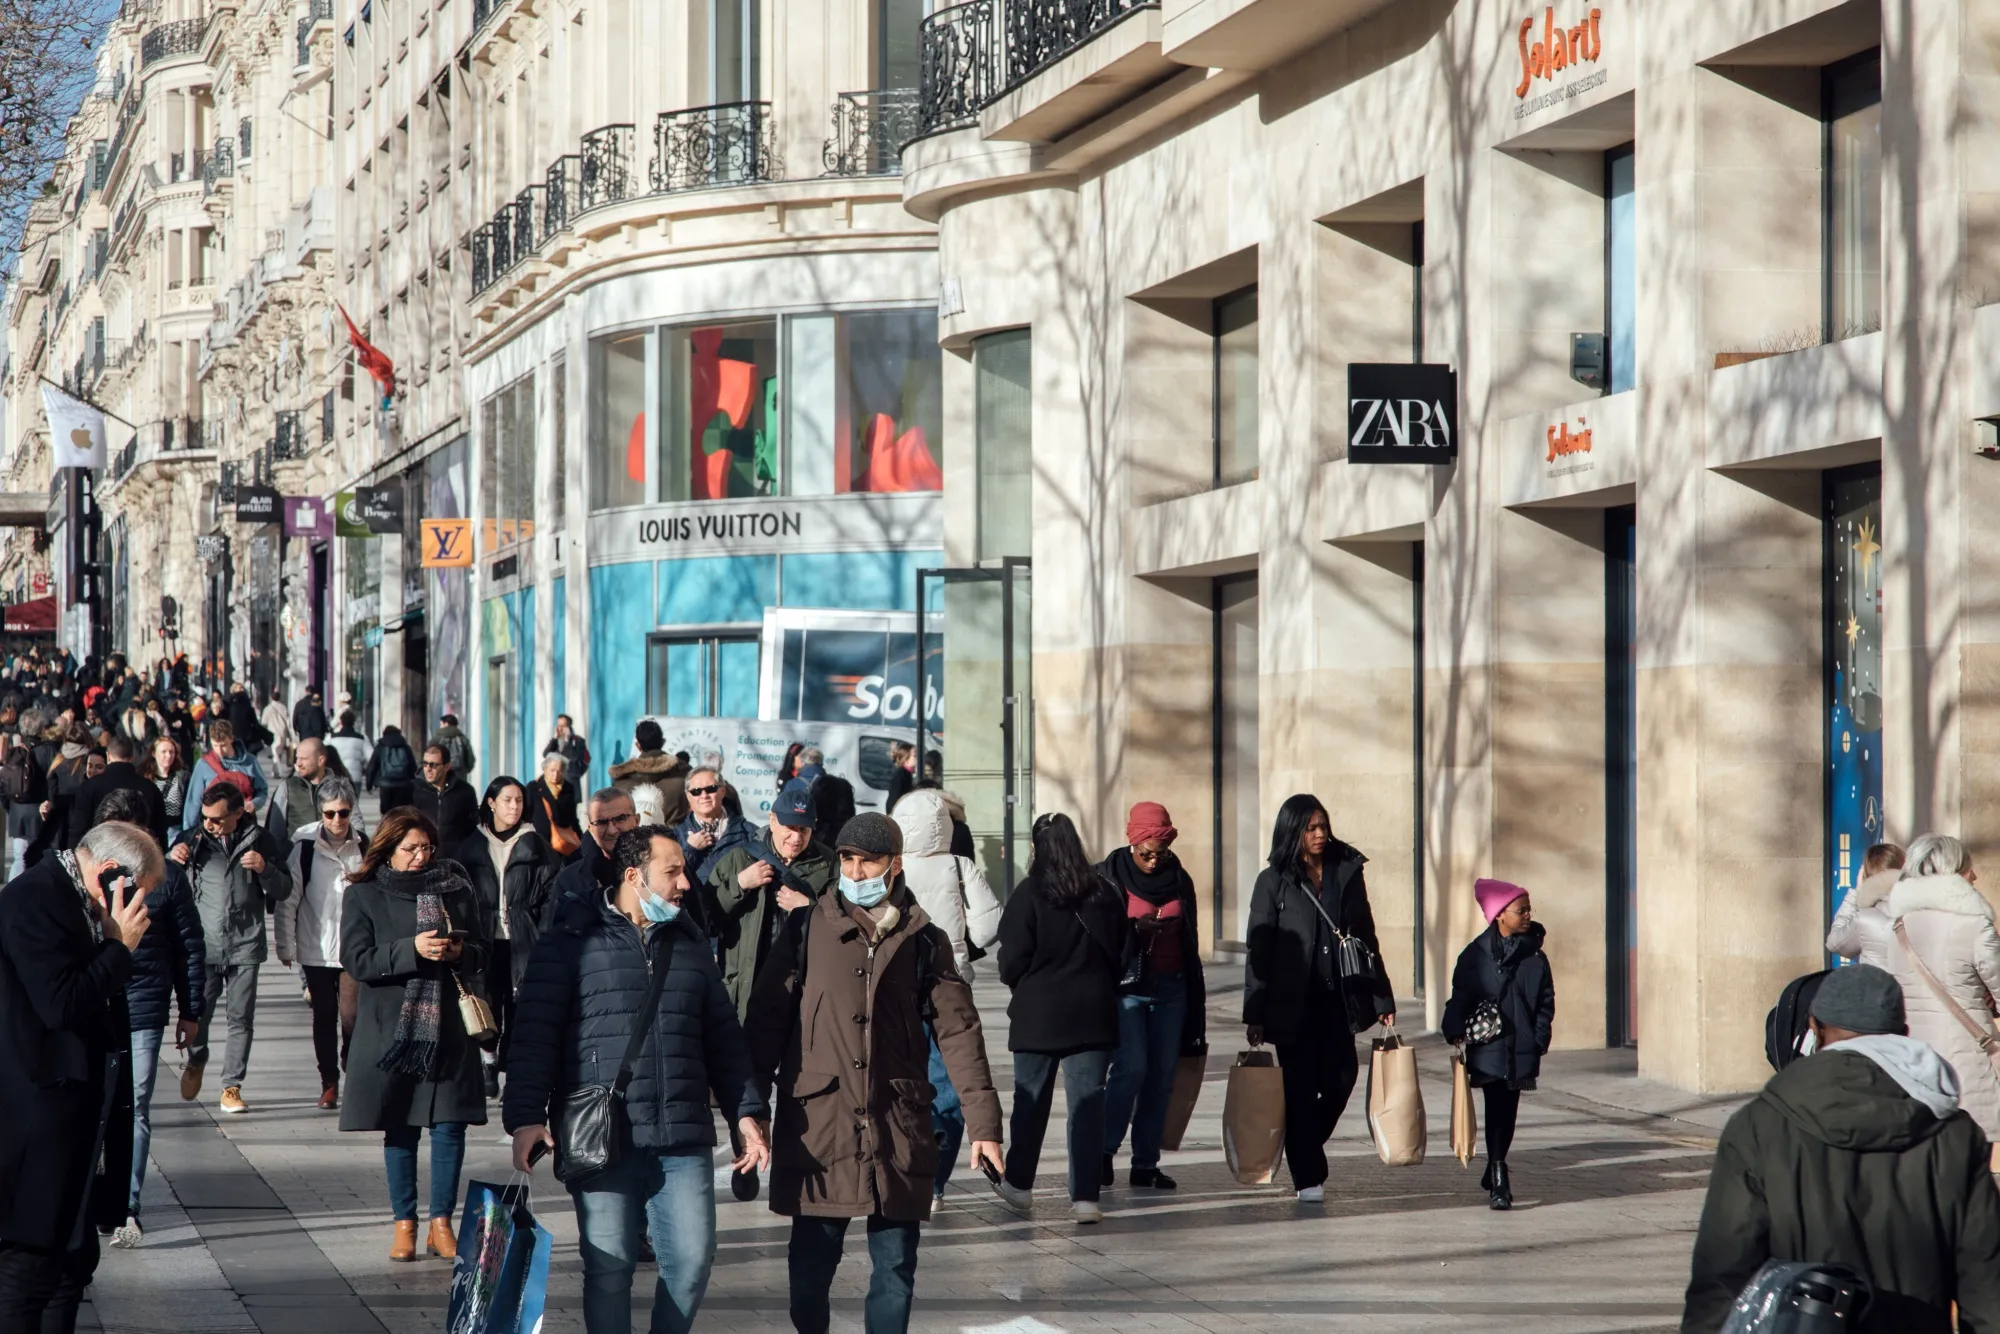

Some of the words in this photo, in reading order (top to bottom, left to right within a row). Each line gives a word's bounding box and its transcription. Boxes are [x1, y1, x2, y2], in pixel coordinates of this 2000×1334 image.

[1516, 2, 1601, 99] Solaris
[1351, 399, 1450, 447] ZARA
[1546, 417, 1592, 464] Solaris
[639, 517, 691, 544] LOUIS
[697, 511, 801, 540] VUITTON
[738, 735, 784, 746] Education
[735, 765, 777, 777] Comport
